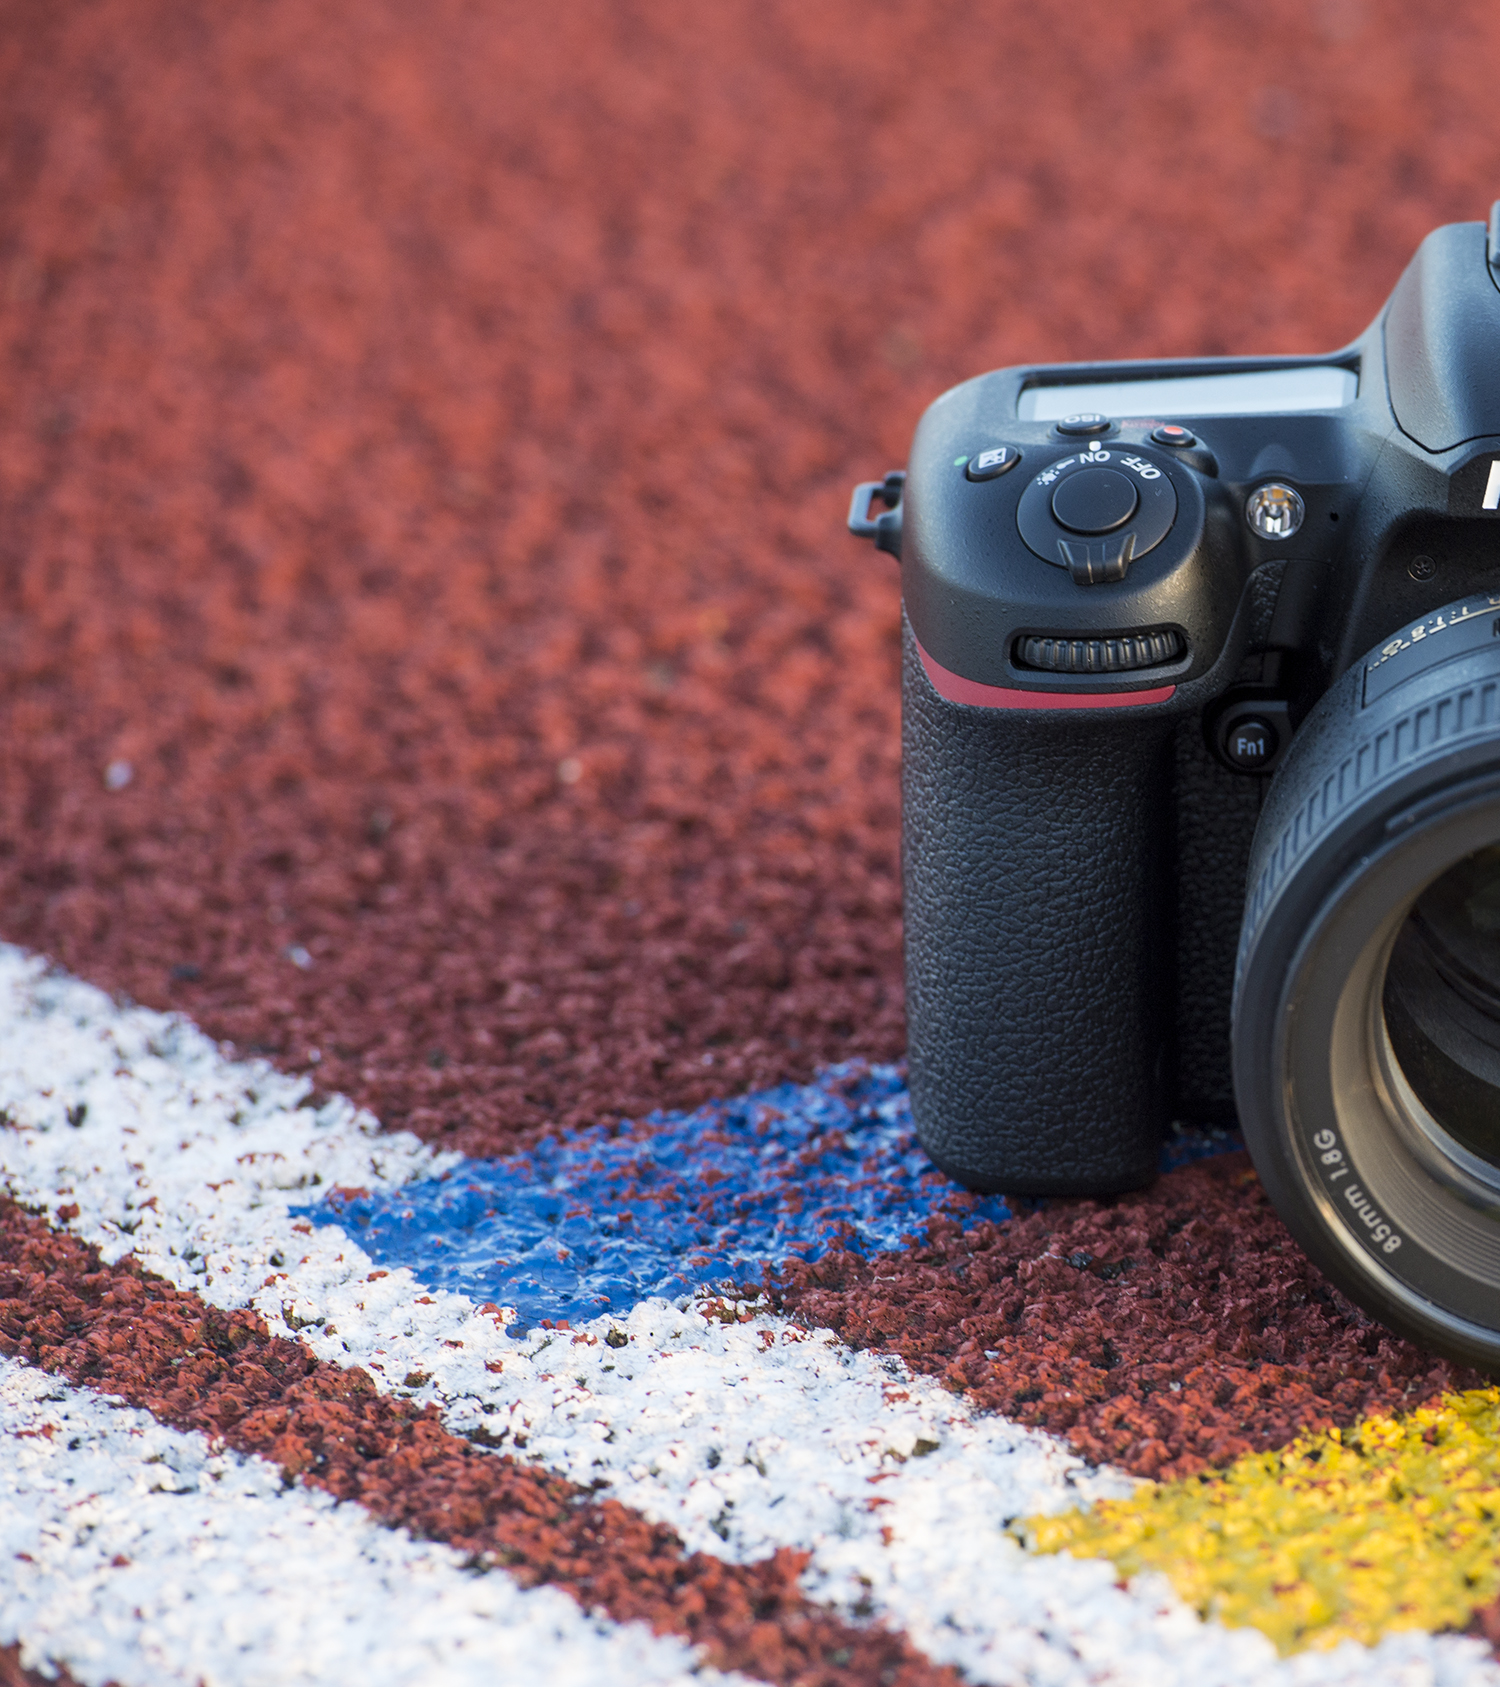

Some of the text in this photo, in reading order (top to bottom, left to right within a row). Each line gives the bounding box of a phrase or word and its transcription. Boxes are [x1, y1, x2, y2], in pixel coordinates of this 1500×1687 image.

[1064, 414, 1101, 424] ISO
[1079, 450, 1111, 464] ON
[1120, 456, 1161, 479] OFF
[1237, 737, 1265, 756] Fn1
[1313, 1128, 1402, 1253] 85mm 1.8G
